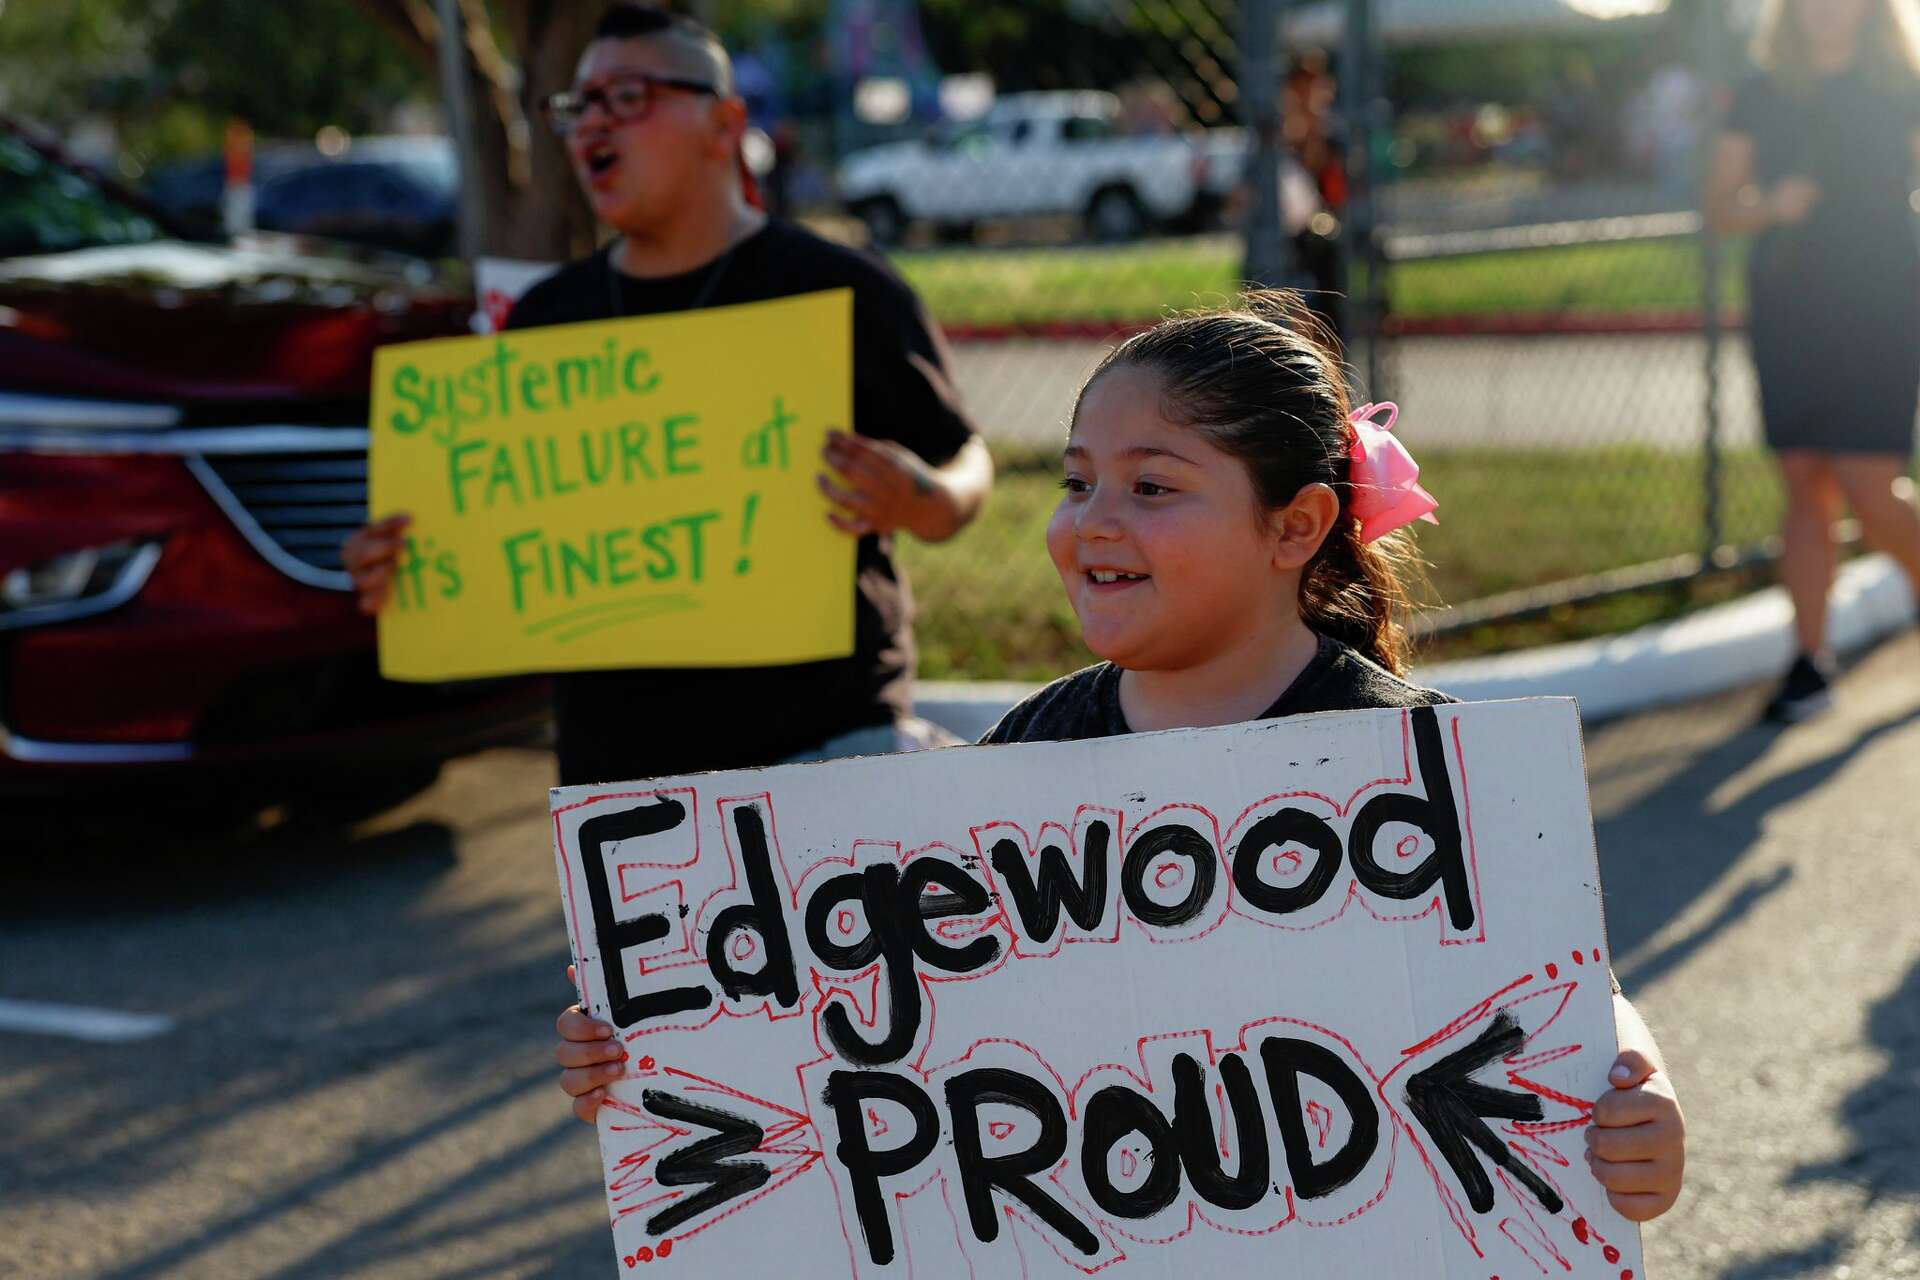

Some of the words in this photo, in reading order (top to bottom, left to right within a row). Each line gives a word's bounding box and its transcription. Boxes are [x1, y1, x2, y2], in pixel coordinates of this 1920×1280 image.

[390, 338, 661, 446] Systemic
[449, 413, 703, 515] FAILURE
[741, 397, 797, 470] at
[578, 702, 1474, 1066] Edgewood
[821, 1036, 1379, 1266] PROUD
